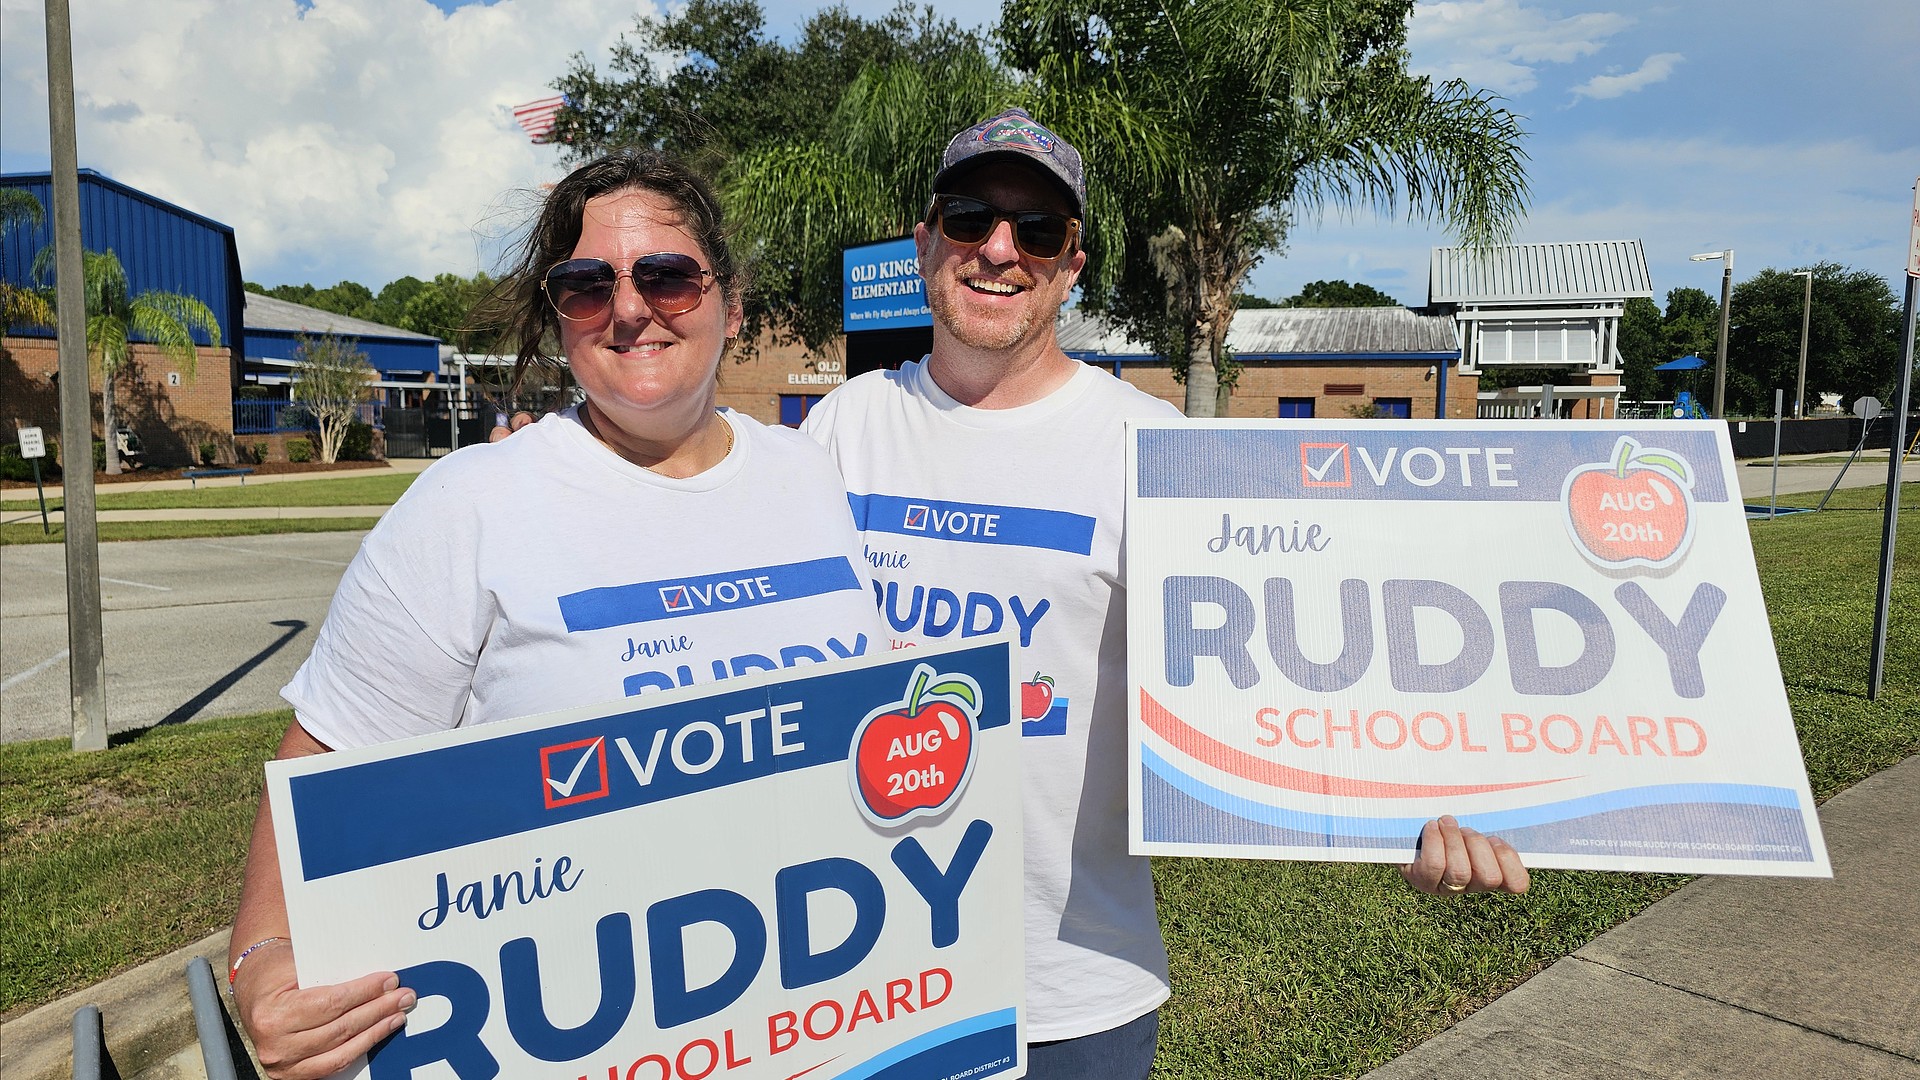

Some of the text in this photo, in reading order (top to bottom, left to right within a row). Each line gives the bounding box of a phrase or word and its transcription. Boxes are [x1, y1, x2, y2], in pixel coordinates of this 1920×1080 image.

[851, 257, 920, 283] OLD KINGS
[851, 279, 922, 300] ELEMENTARY
[850, 312, 864, 320] Where
[864, 310, 872, 319] We
[881, 309, 893, 319] Right
[894, 308, 902, 317] and
[903, 307, 920, 316] Always
[171, 374, 177, 385] 2
[788, 373, 847, 385] ELEMENTA
[818, 361, 840, 372] OLD
[1356, 447, 1519, 487] VOTE
[1599, 492, 1655, 512] AUG
[932, 509, 1000, 537] VOTE
[1207, 513, 1331, 556] Janie
[1602, 523, 1663, 543] 20th
[690, 576, 777, 606] VOTE
[872, 579, 1051, 648] UDDY
[621, 635, 693, 662] Janie
[1163, 575, 1728, 699] RUDDY
[615, 701, 805, 787] VOTE
[886, 730, 942, 761] AUG
[1255, 707, 1708, 758] SCHOOL BOARD
[887, 764, 945, 797] 20th
[1569, 839, 1589, 847] PAID
[1607, 840, 1618, 848] BY
[1619, 840, 1642, 848] JANIE
[1643, 841, 1671, 849] RUDDY
[1691, 843, 1724, 851] SCHOOL
[1726, 844, 1754, 852] BOARD
[1756, 845, 1790, 853] DISTRICT
[418, 855, 584, 930] Janie
[367, 819, 994, 1080] RUDDY
[768, 967, 953, 1056] BOARD
[974, 1059, 1002, 1074] DISTRICT
[1002, 1056, 1010, 1064] #3
